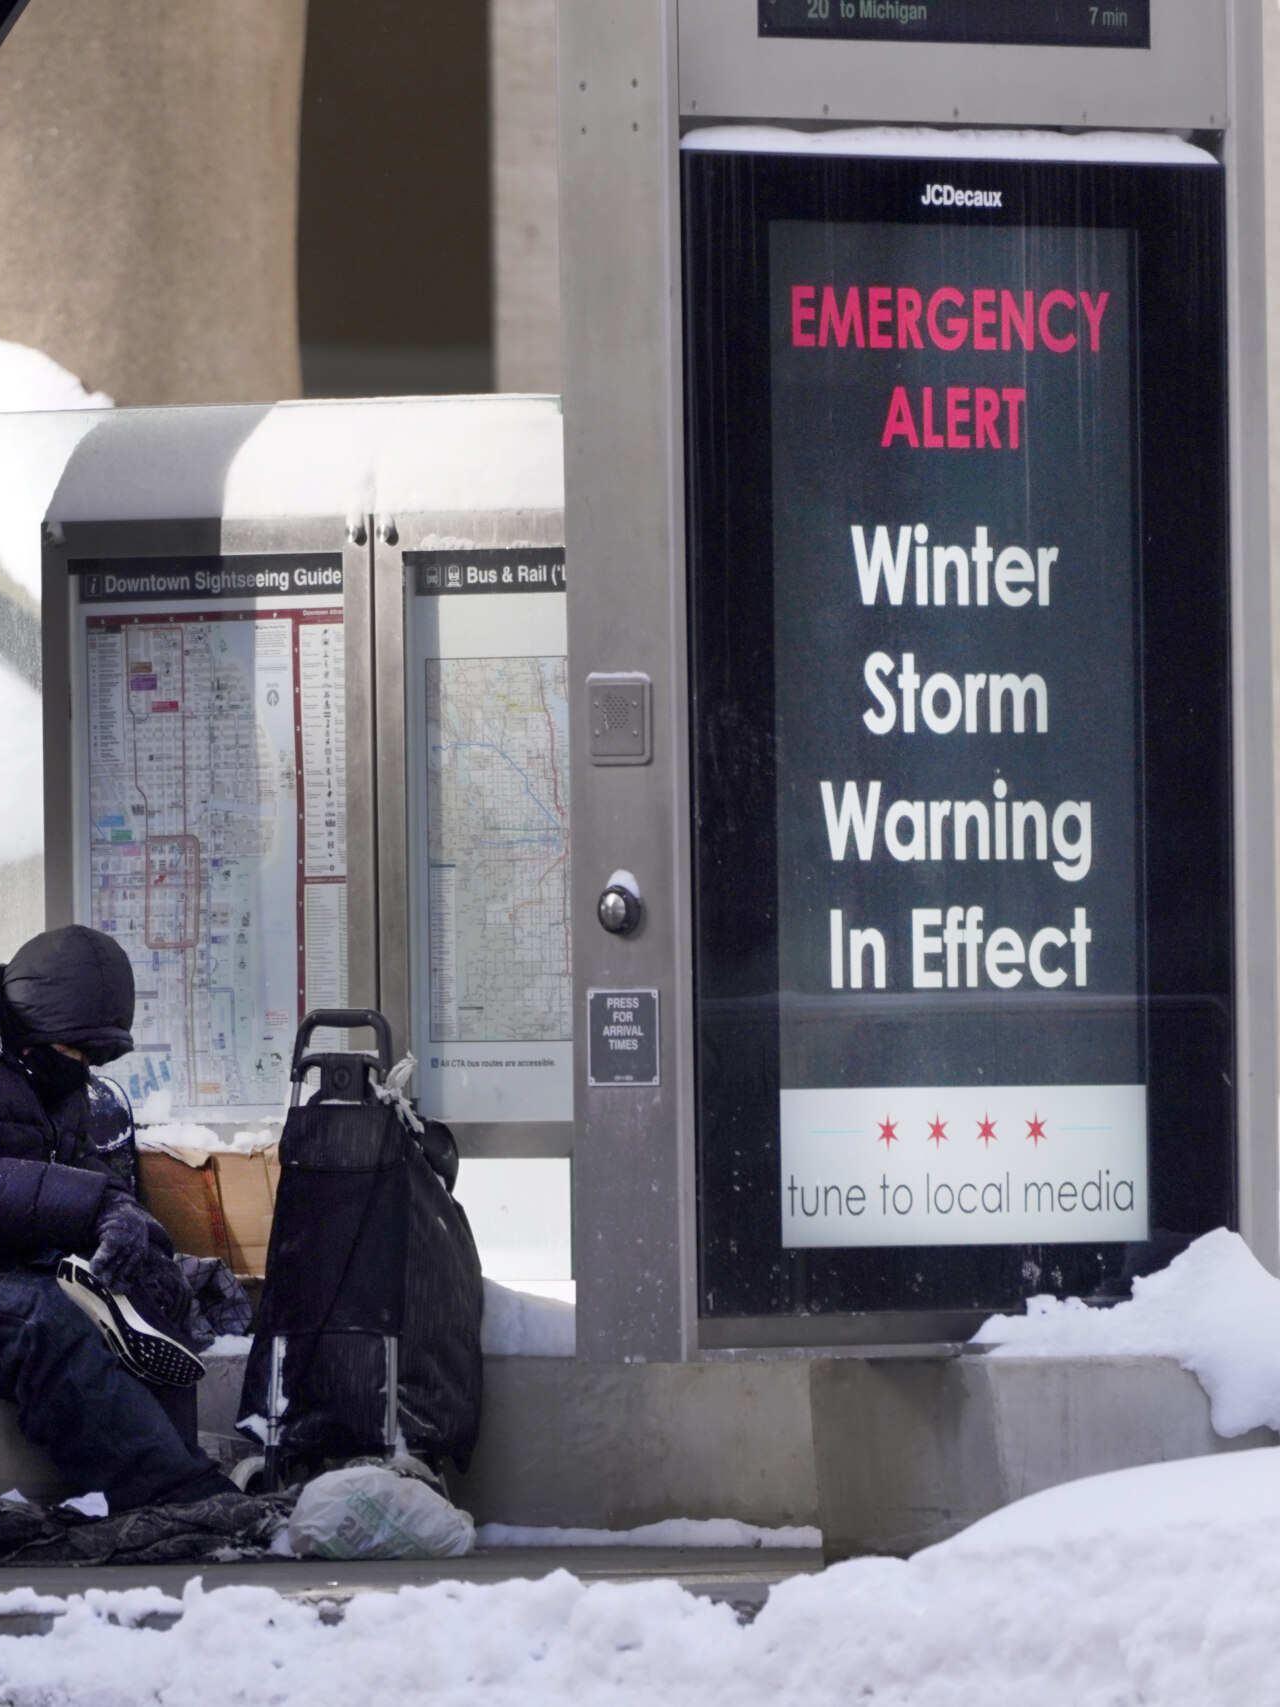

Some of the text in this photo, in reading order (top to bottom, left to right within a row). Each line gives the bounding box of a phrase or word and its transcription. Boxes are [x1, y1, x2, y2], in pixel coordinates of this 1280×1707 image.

[839, 2, 856, 18] to
[859, 1, 928, 24] Michigan
[1089, 6, 1128, 26] 7 min
[921, 183, 1003, 208] JCDecaux
[791, 285, 1110, 353] EMERGENCY
[880, 385, 1026, 450] ALERT
[466, 566, 498, 584] Bus
[501, 565, 514, 583] &
[517, 564, 547, 583] Rail
[850, 523, 1060, 607] Winter
[105, 567, 343, 595] Downtown Sightseeing Guide
[862, 651, 1049, 735] Storm
[820, 778, 1093, 882] Warning
[829, 906, 1093, 990] In Effect
[606, 997, 640, 1009] PRESS
[612, 1011, 634, 1023] FOR
[602, 1025, 644, 1037] ARRIVAL
[608, 1038, 639, 1051] TIMES
[451, 1059, 465, 1068] CTA
[467, 1058, 480, 1068] bus
[481, 1059, 503, 1068] routes
[505, 1060, 516, 1068] are
[787, 1169, 1135, 1218] tune to local media
